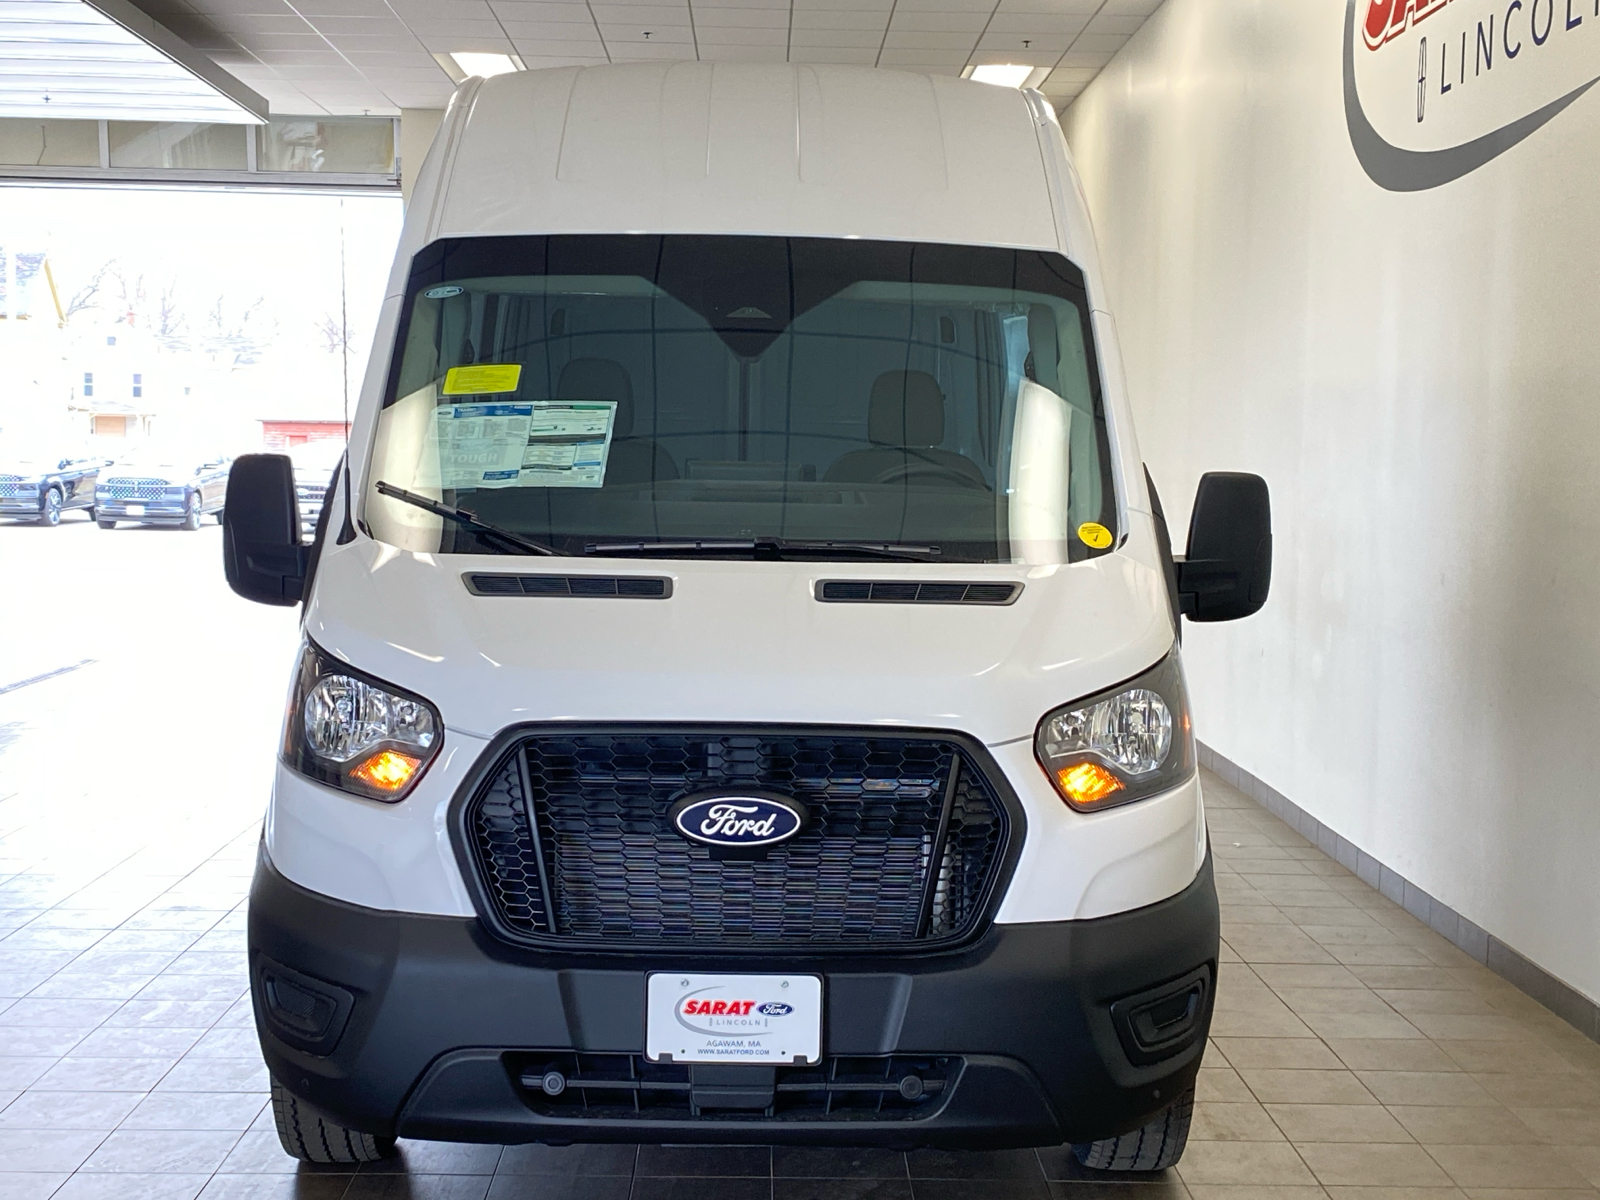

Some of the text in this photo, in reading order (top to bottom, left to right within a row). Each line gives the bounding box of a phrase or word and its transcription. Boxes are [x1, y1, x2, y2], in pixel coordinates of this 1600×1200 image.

[1440, 0, 1600, 95] LINCOL
[449, 452, 498, 464] TOUGH
[700, 804, 777, 836] Ford
[683, 999, 788, 1016] SARAT Ford
[706, 1040, 746, 1048] AGAWAM,
